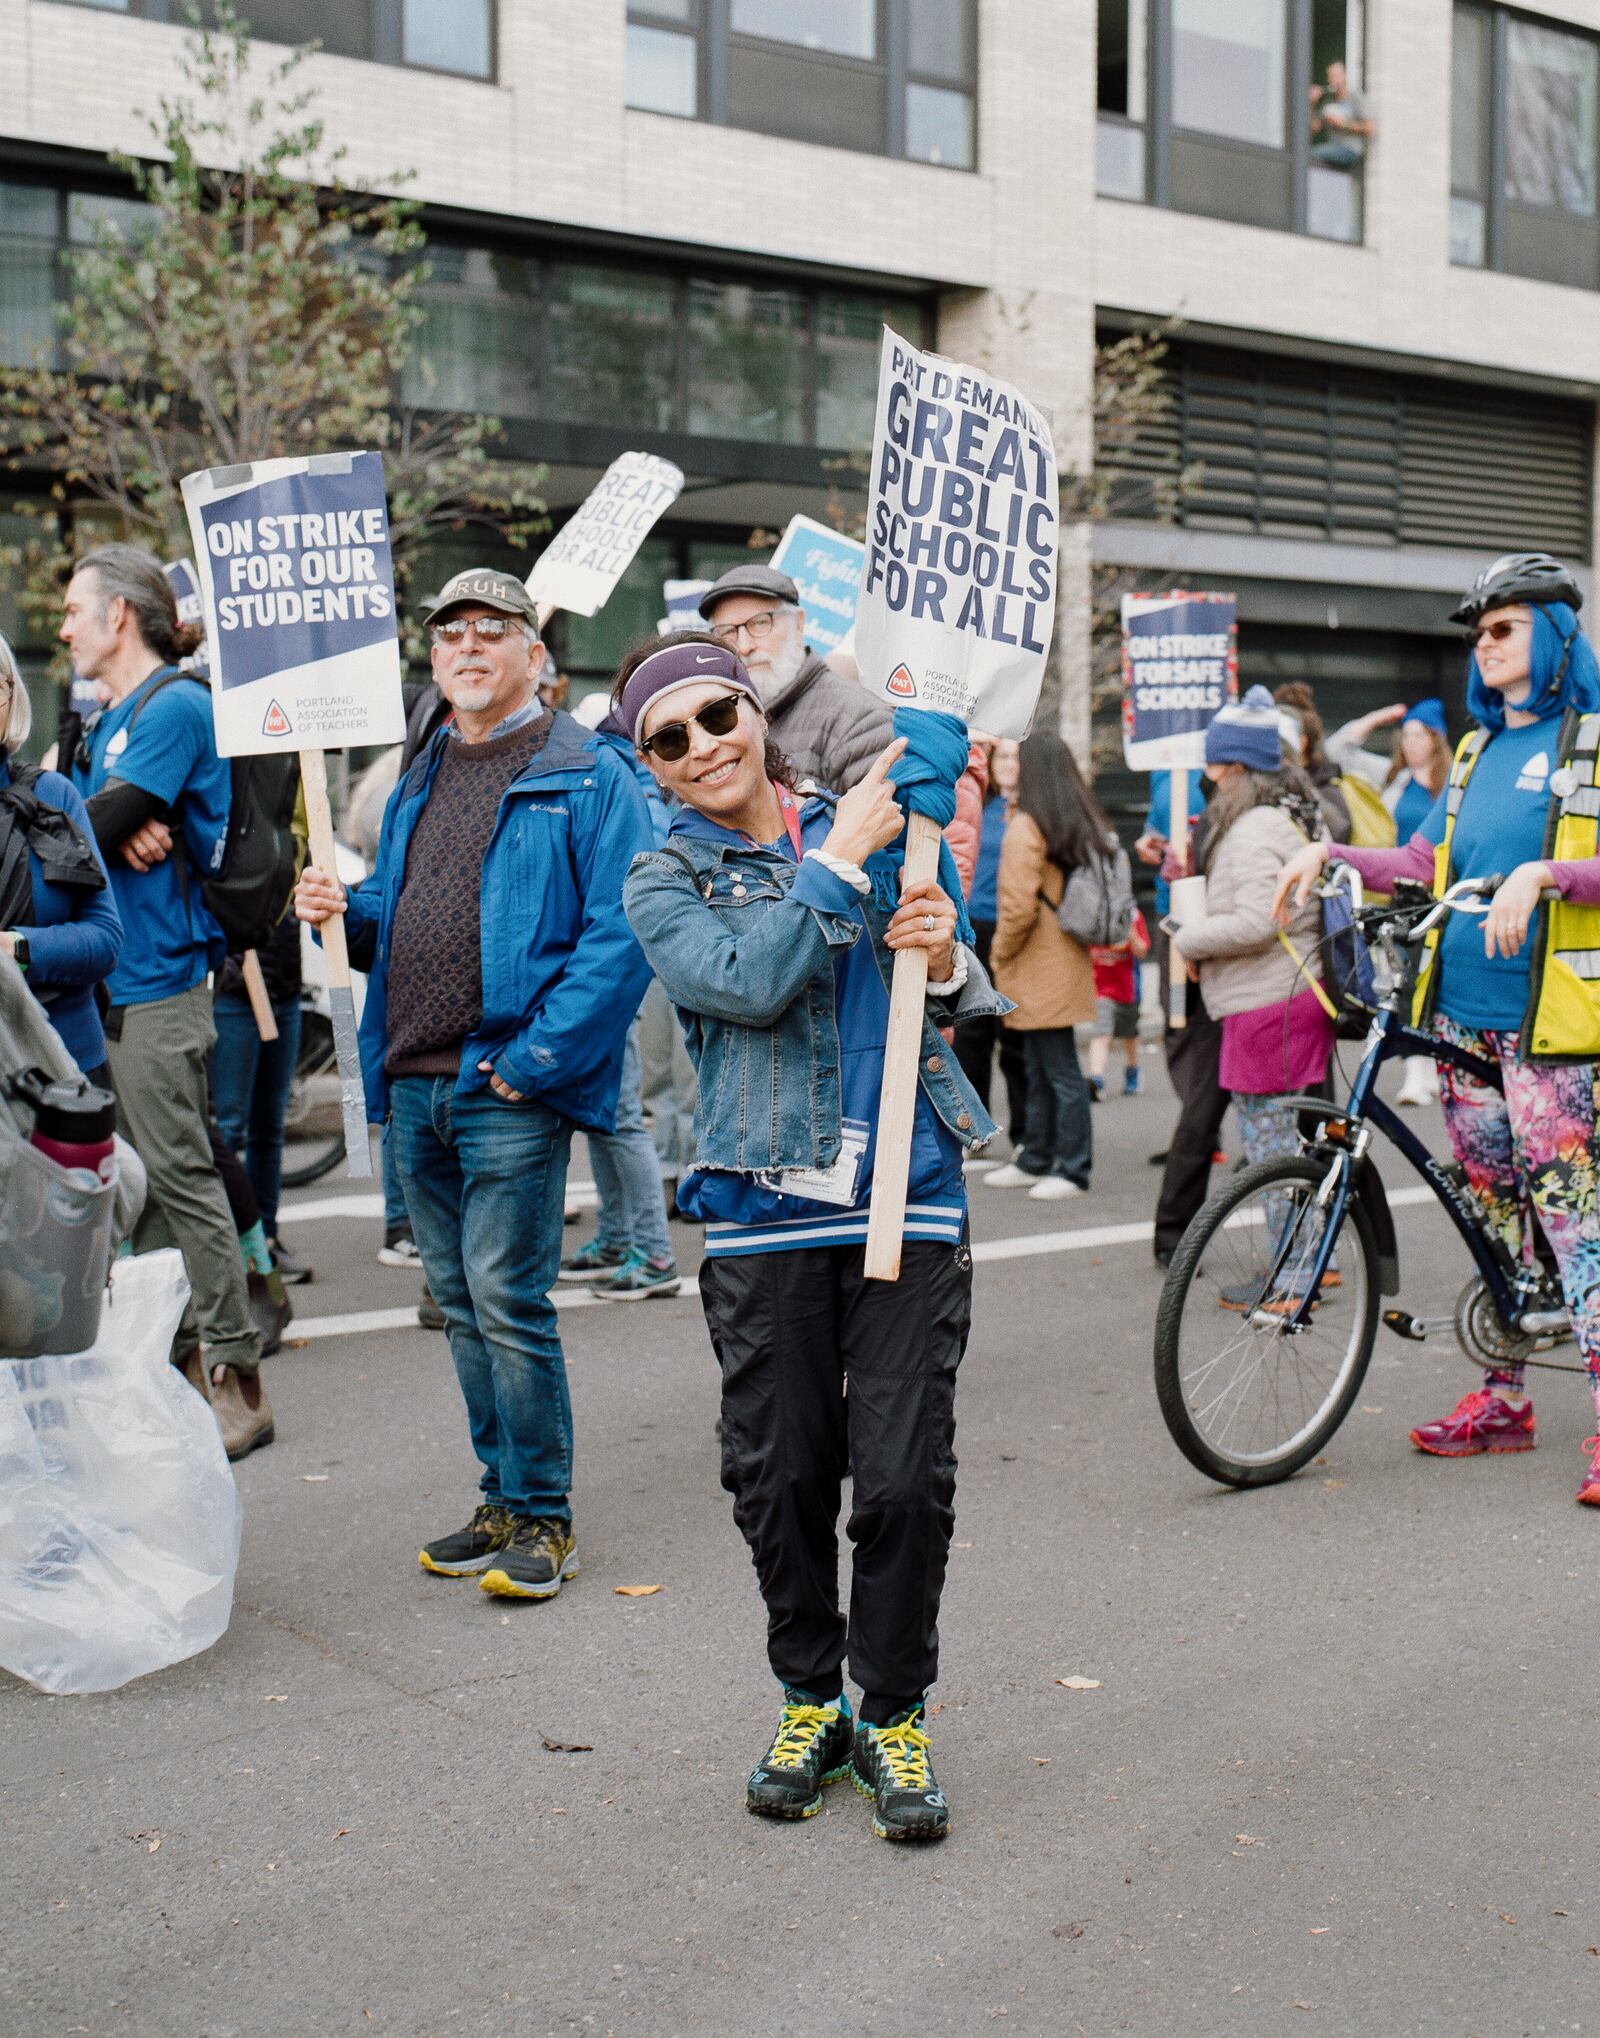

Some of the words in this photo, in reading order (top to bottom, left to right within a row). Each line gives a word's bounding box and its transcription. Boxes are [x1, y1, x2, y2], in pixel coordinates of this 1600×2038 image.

[892, 345, 927, 391] PAT
[887, 381, 1053, 500] GREAT
[600, 472, 675, 506] REAT
[879, 440, 1054, 557] PUBLIC
[581, 500, 654, 531] UBLIC
[207, 518, 253, 557] ON
[257, 508, 386, 551] STRIKE
[550, 543, 580, 563] OR
[578, 548, 622, 575] ALL
[873, 500, 1051, 602] SCHOOLS
[229, 552, 295, 593] FOR
[299, 547, 378, 586] OUR
[217, 584, 392, 631] STUDENTS
[866, 544, 948, 623] FOR
[955, 585, 1044, 654] ALL
[1129, 635, 1158, 659] ON
[1159, 634, 1229, 658] STRIKE
[892, 677, 910, 688] PAT
[1134, 661, 1172, 685] FOR
[1173, 659, 1224, 685] SAFE
[296, 696, 354, 708] PORTLAND
[922, 691, 936, 701] OF
[1136, 686, 1222, 711] SCHOOLS
[297, 707, 368, 720] ASSOCIATION
[298, 723, 312, 732] OF
[316, 719, 369, 731] TEACHERS
